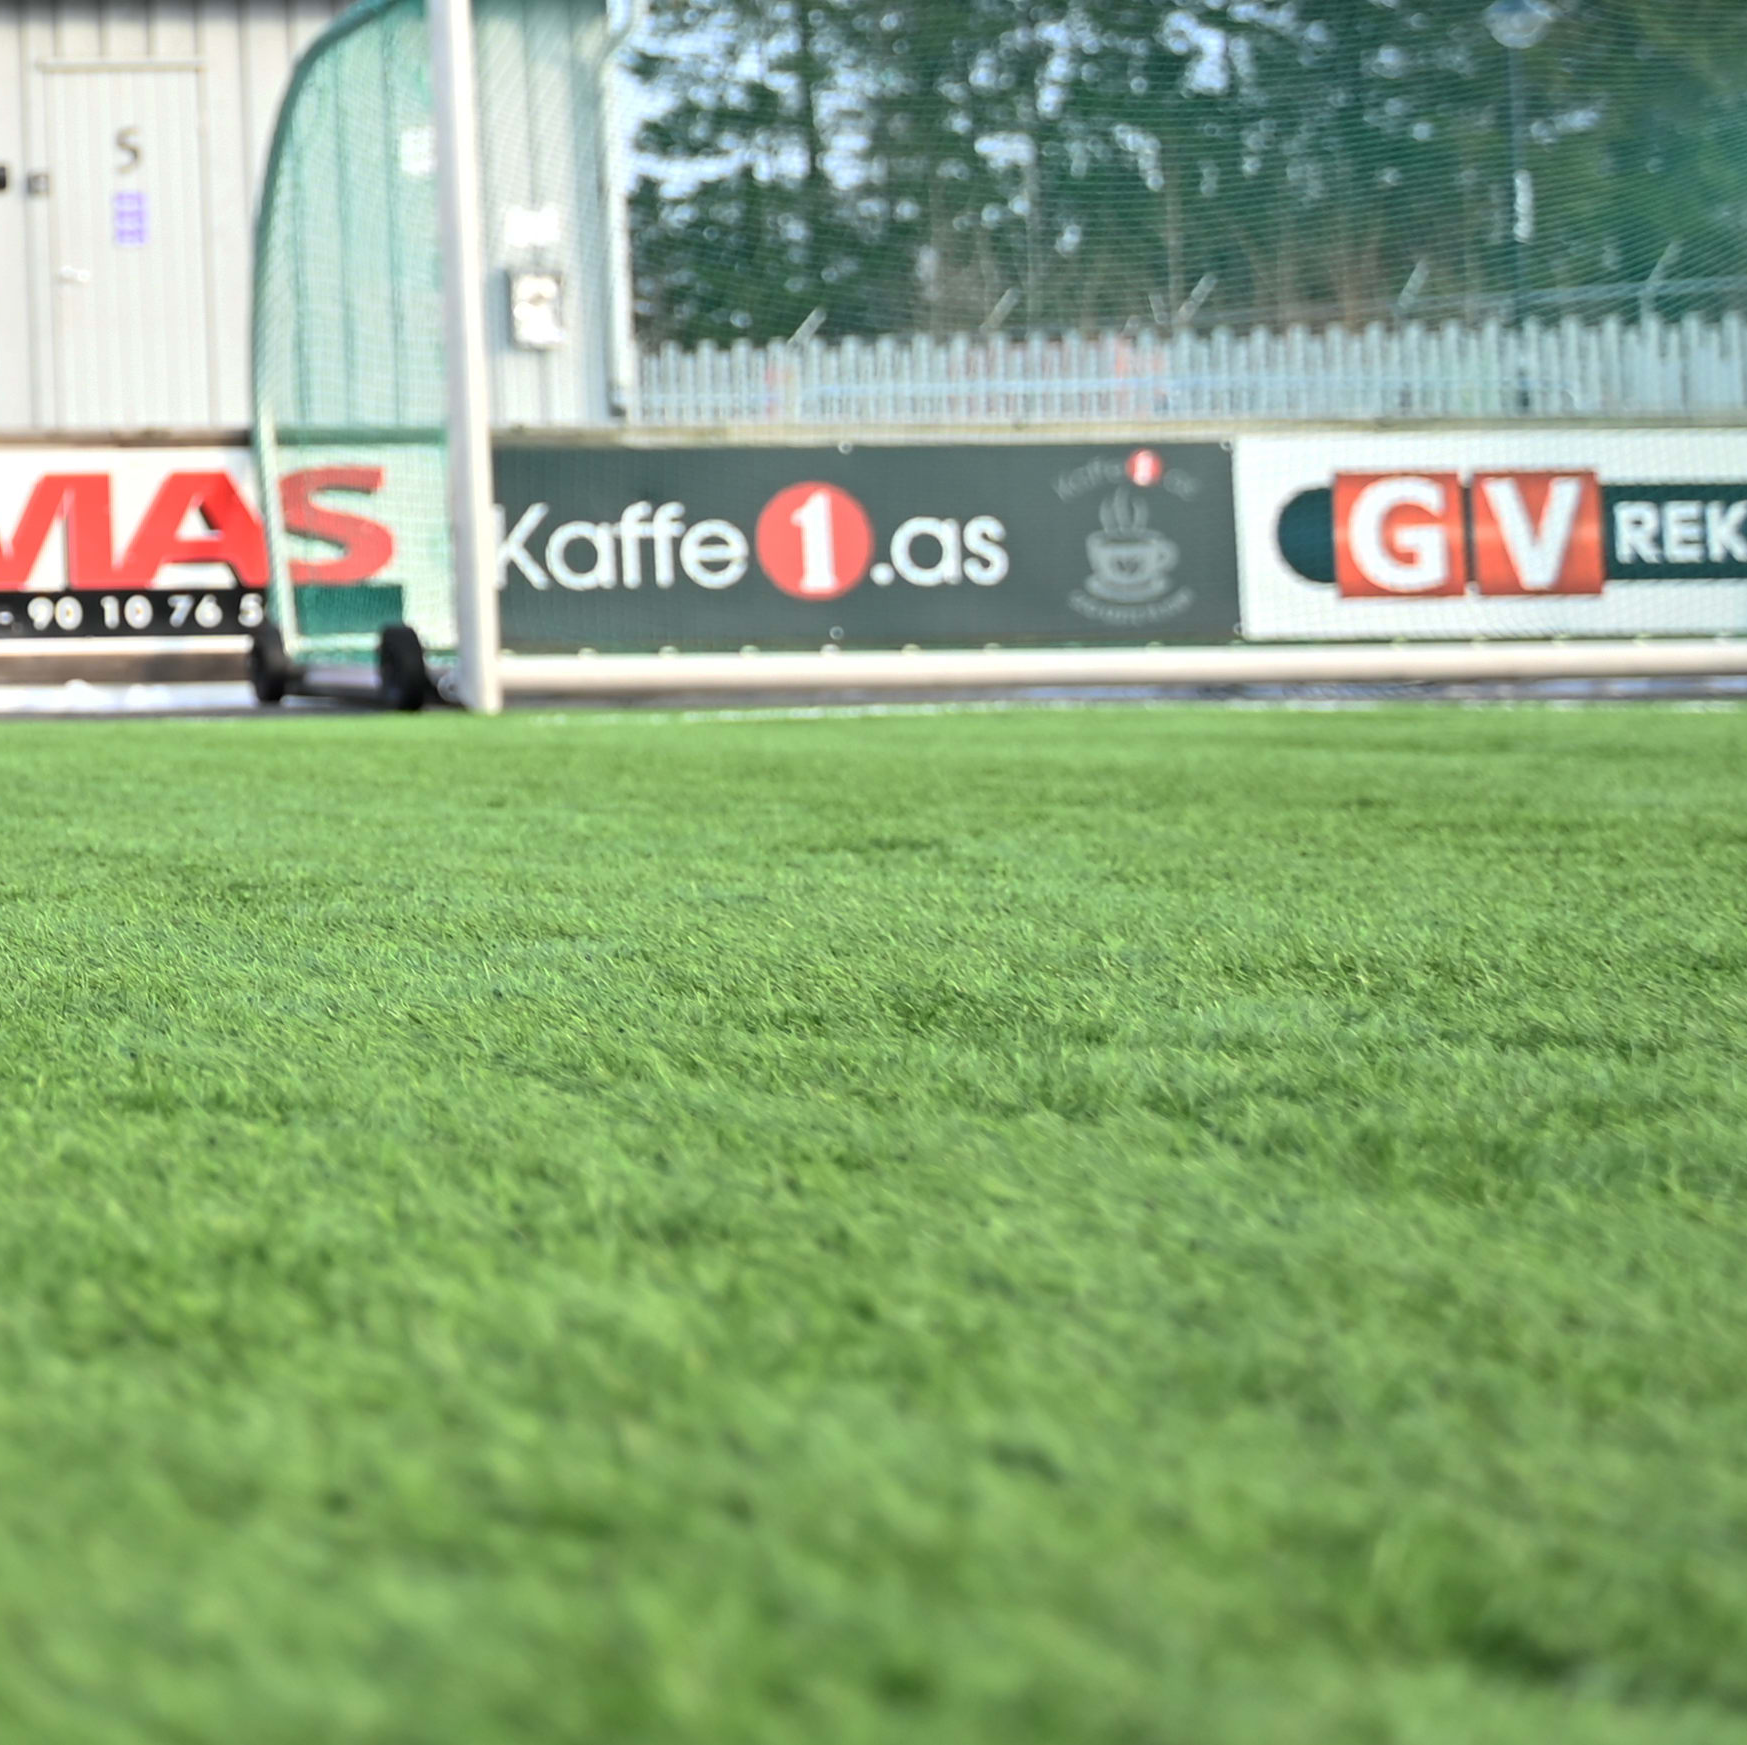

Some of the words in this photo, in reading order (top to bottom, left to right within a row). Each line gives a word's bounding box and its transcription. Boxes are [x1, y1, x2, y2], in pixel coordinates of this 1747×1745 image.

[115, 127, 142, 175] 5
[27, 595, 83, 631] 90
[100, 594, 153, 629] 10
[168, 594, 223, 629] 76
[238, 593, 264, 628] 5
